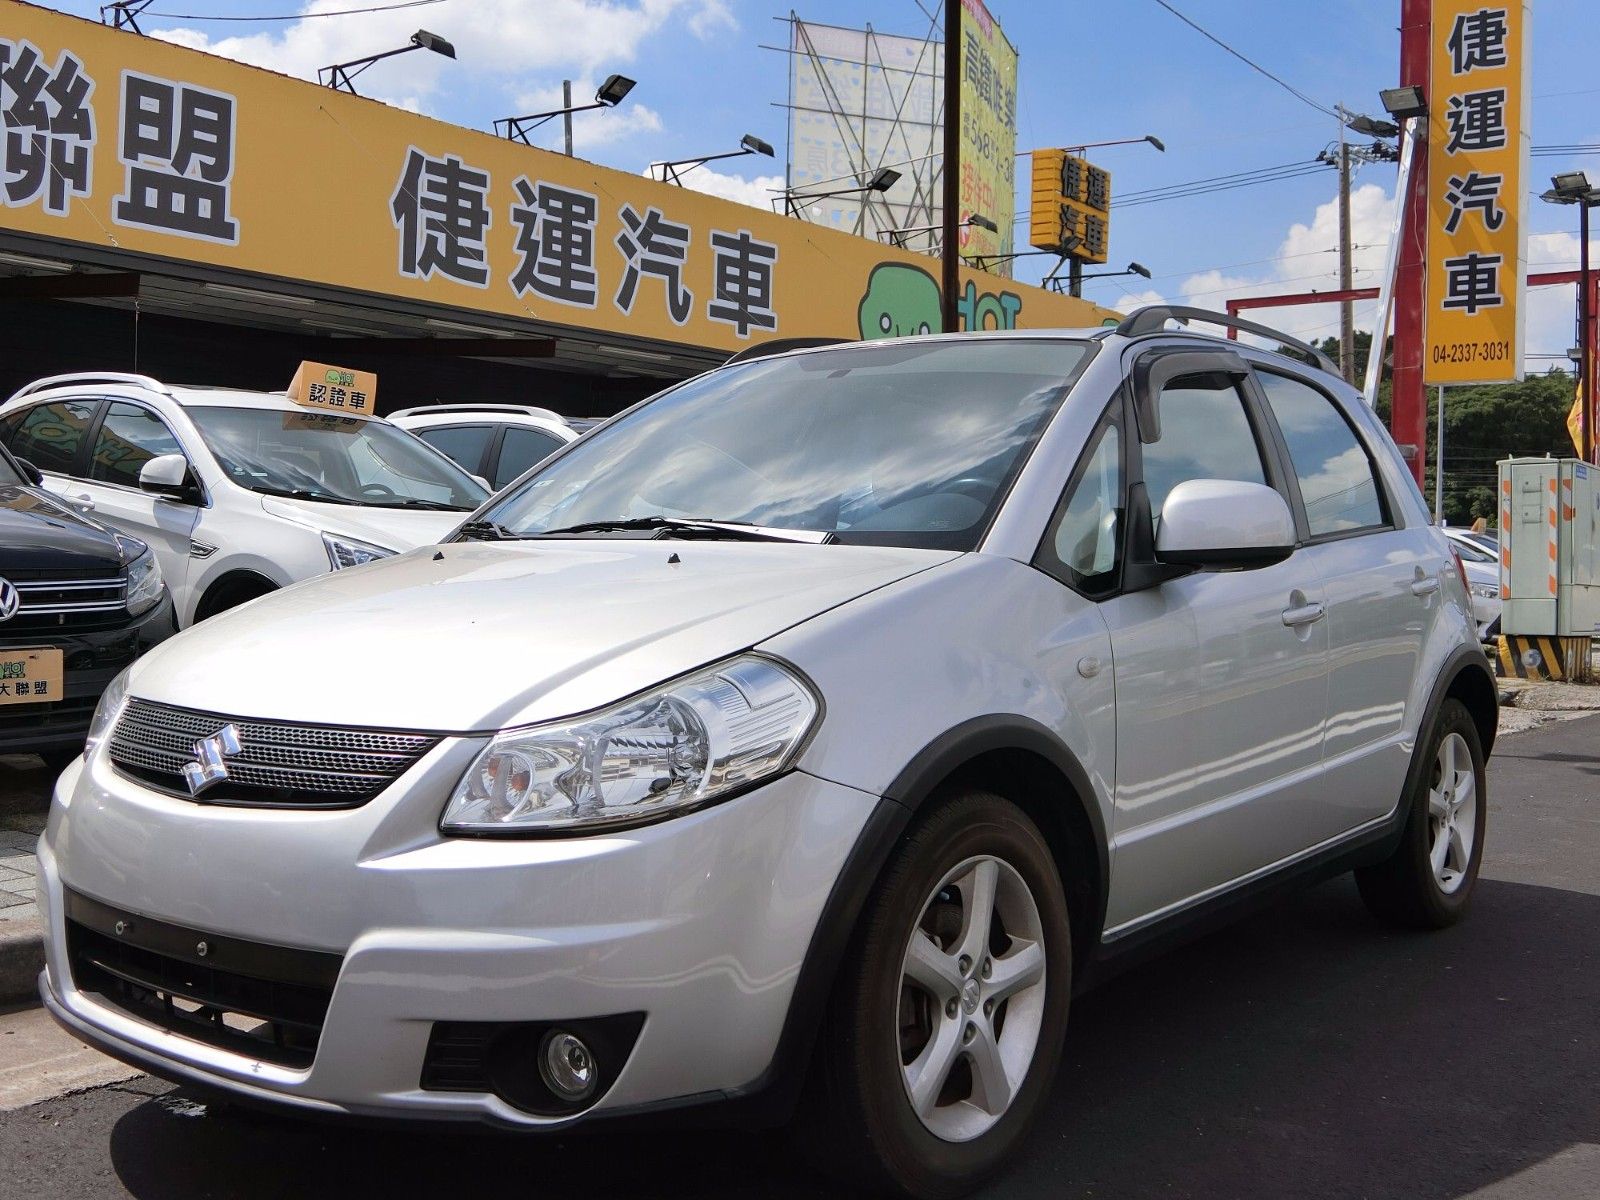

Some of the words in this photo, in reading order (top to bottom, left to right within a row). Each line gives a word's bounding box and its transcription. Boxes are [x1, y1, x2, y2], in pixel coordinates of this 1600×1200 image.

[1433, 340, 1509, 363] 04-2337-3031
[309, 383, 366, 409] 認證車
[0, 681, 48, 697] 大聯盟
